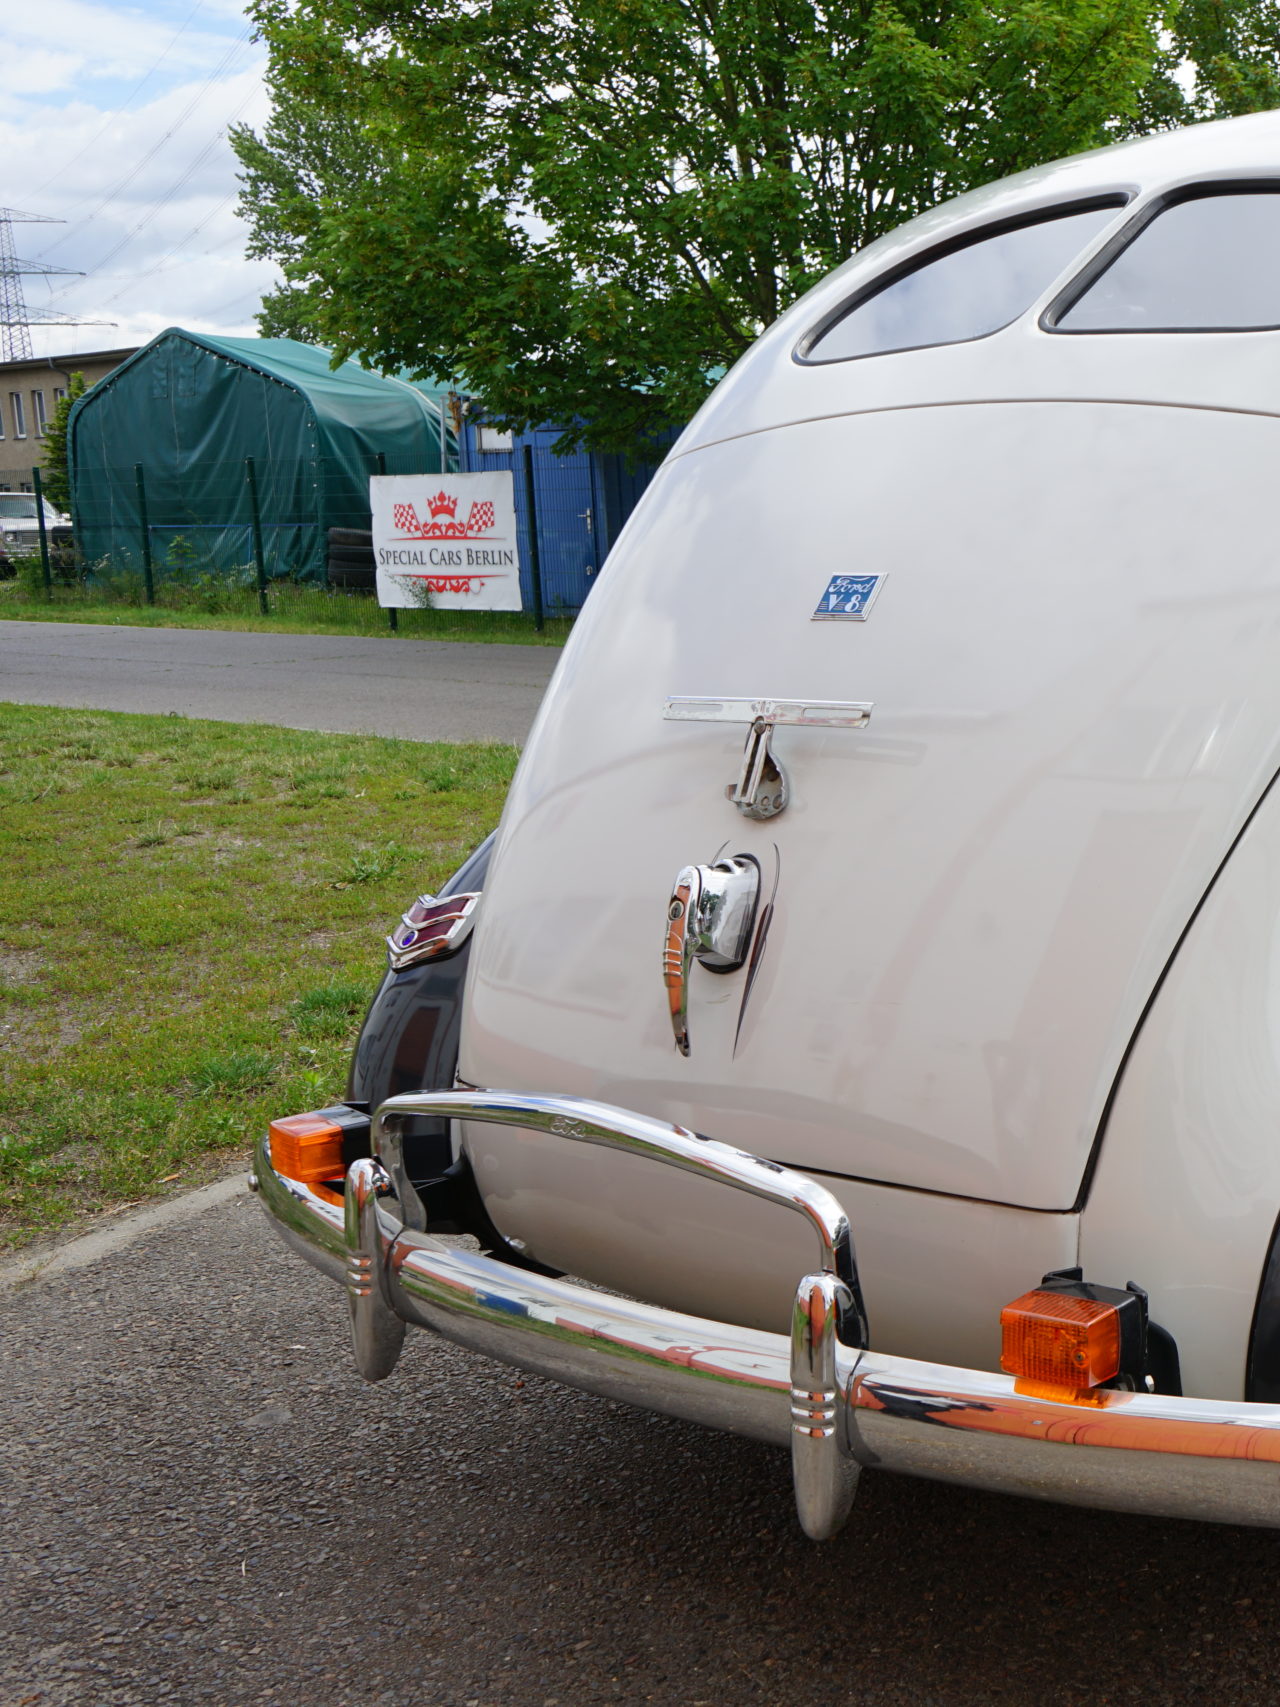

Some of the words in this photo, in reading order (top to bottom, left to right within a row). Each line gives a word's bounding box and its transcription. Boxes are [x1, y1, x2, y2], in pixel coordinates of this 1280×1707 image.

[379, 548, 427, 566] SPECIAL
[429, 548, 462, 566] CARS
[466, 548, 514, 566] BERLIN
[828, 576, 875, 592] Ford
